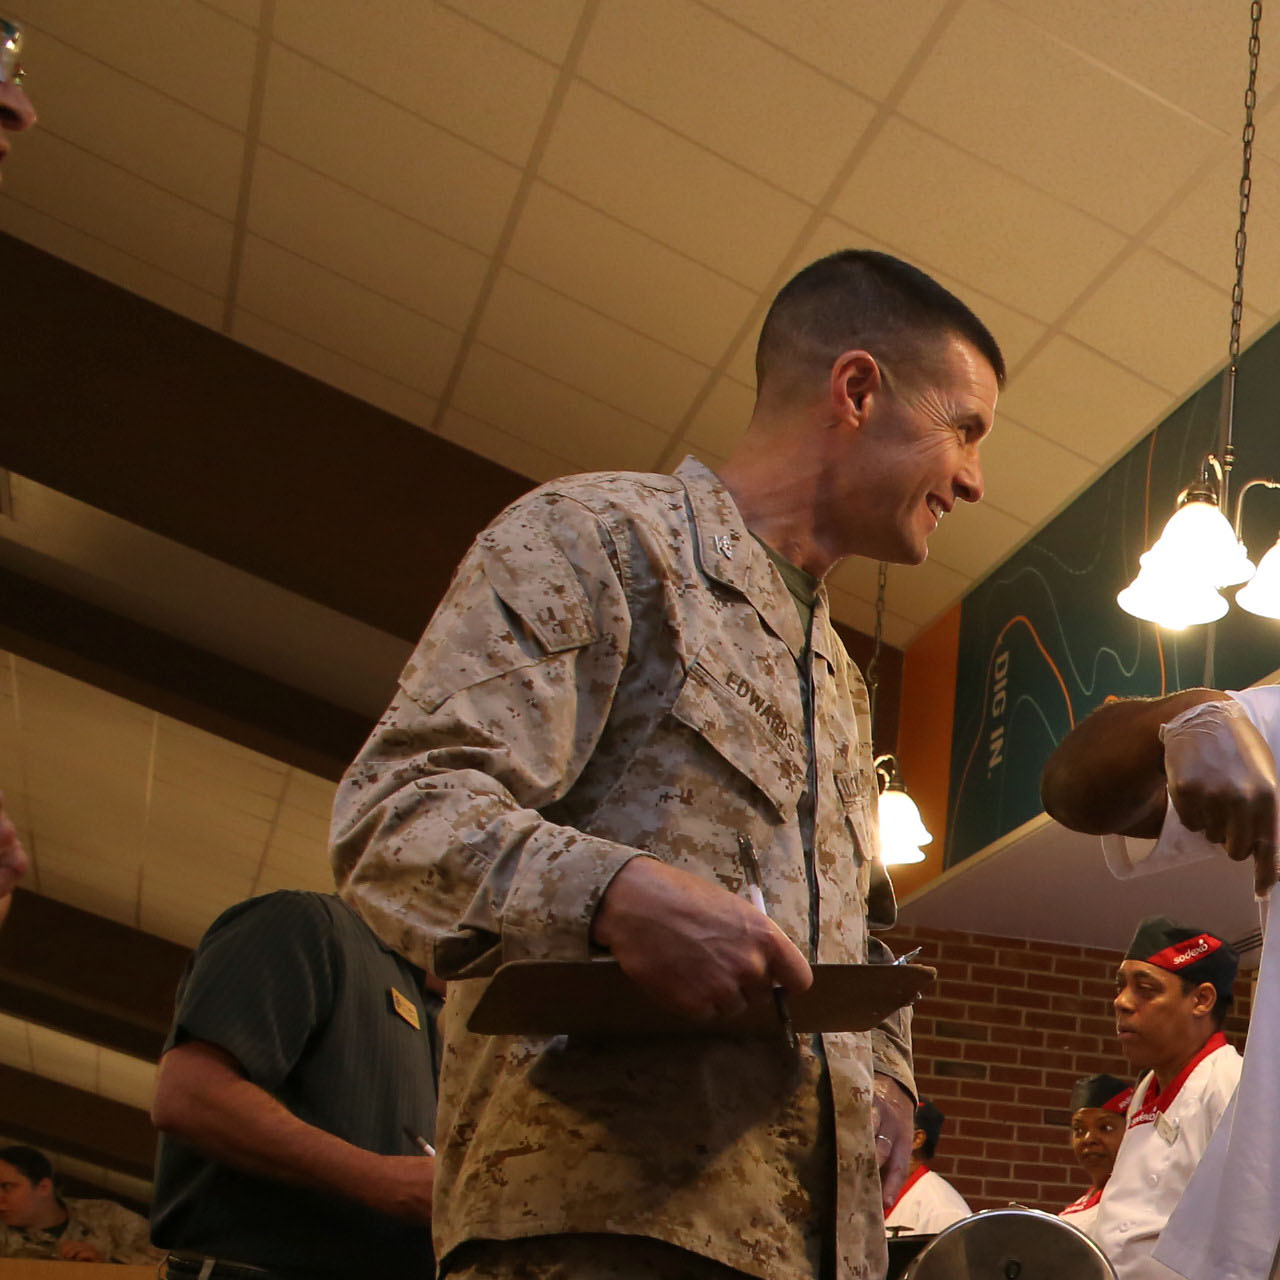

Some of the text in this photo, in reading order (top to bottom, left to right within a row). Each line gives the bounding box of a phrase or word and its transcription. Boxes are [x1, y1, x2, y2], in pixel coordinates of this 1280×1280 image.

[726, 672, 796, 751] EDWARDS
[991, 650, 1009, 718] DIG
[1173, 938, 1208, 965] sodexo
